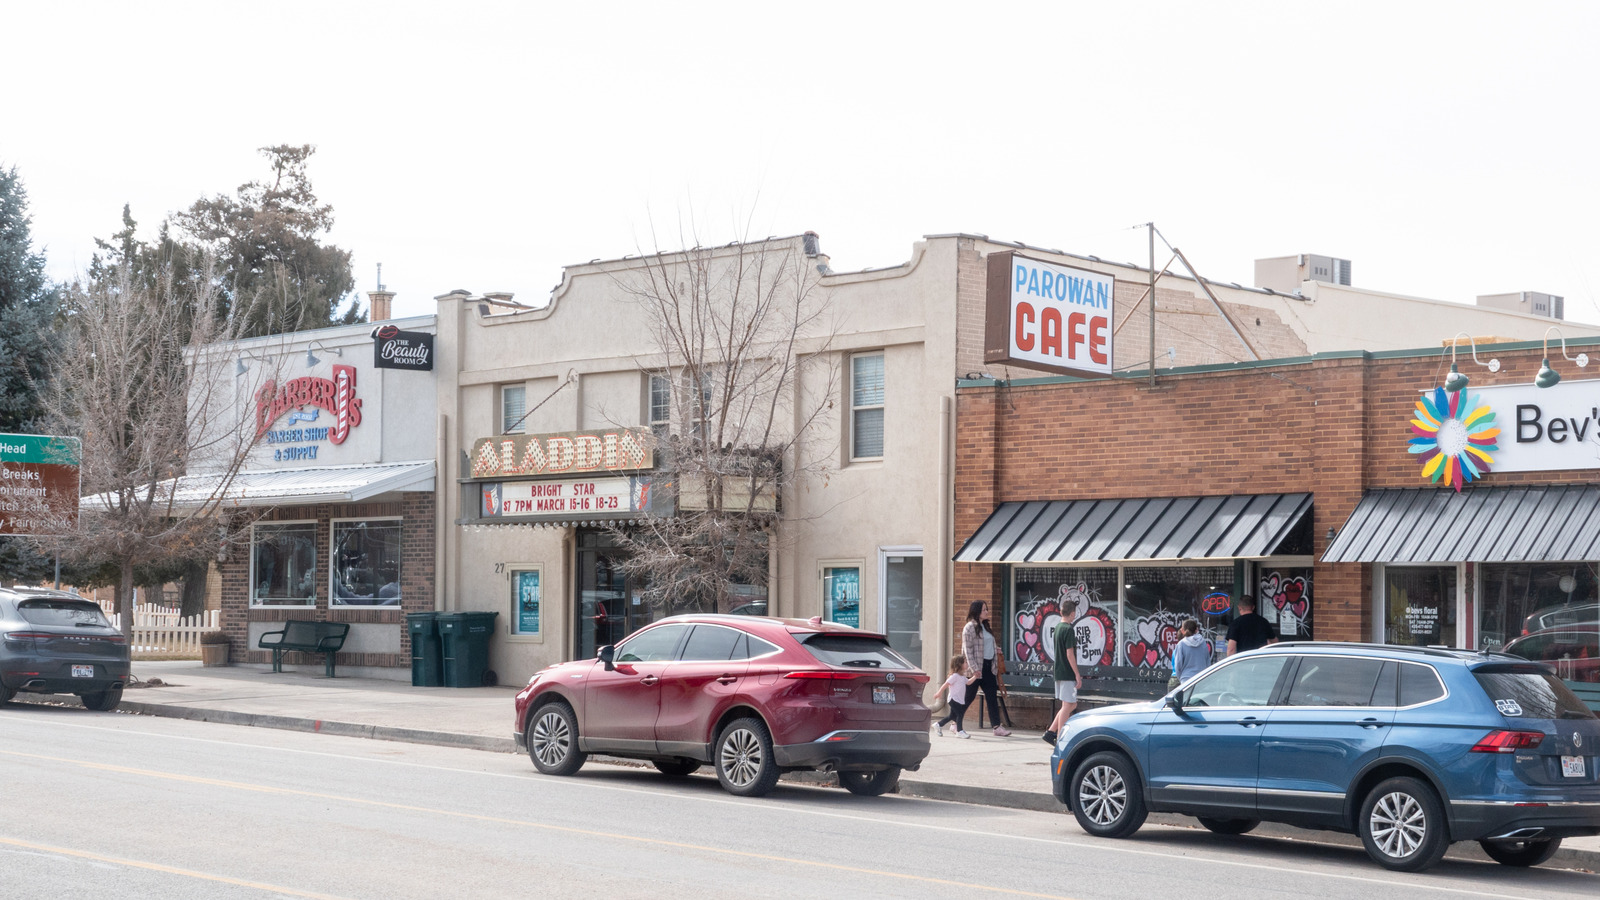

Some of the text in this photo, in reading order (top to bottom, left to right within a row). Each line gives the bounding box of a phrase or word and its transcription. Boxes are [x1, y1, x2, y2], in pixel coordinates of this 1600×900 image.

[1015, 264, 1108, 310] PAROWAN
[1015, 301, 1108, 365] CAFE
[381, 340, 429, 365] Beauty
[393, 357, 416, 365] ROOM
[1516, 404, 1600, 444] Bev'
[267, 427, 329, 444] BARBER SHOP
[0, 442, 26, 454] Head
[274, 445, 319, 461] & SUPPLY
[473, 430, 647, 476] ALADDIN
[2, 468, 40, 480] Breaks
[0, 486, 47, 497] onument
[531, 483, 595, 497] BRIGHT STAR
[503, 496, 618, 512] $7 7PM MARCH 15-16 18-23
[495, 562, 505, 574] 27
[836, 582, 859, 600] STAR
[1202, 595, 1230, 612] OPEN
[1424, 606, 1438, 615] floral
[1076, 626, 1091, 636] RIB
[1166, 631, 1178, 642] BE
[1075, 635, 1092, 645] NER
[1082, 644, 1102, 661] 5pm
[1017, 663, 1054, 672] PAROWA
